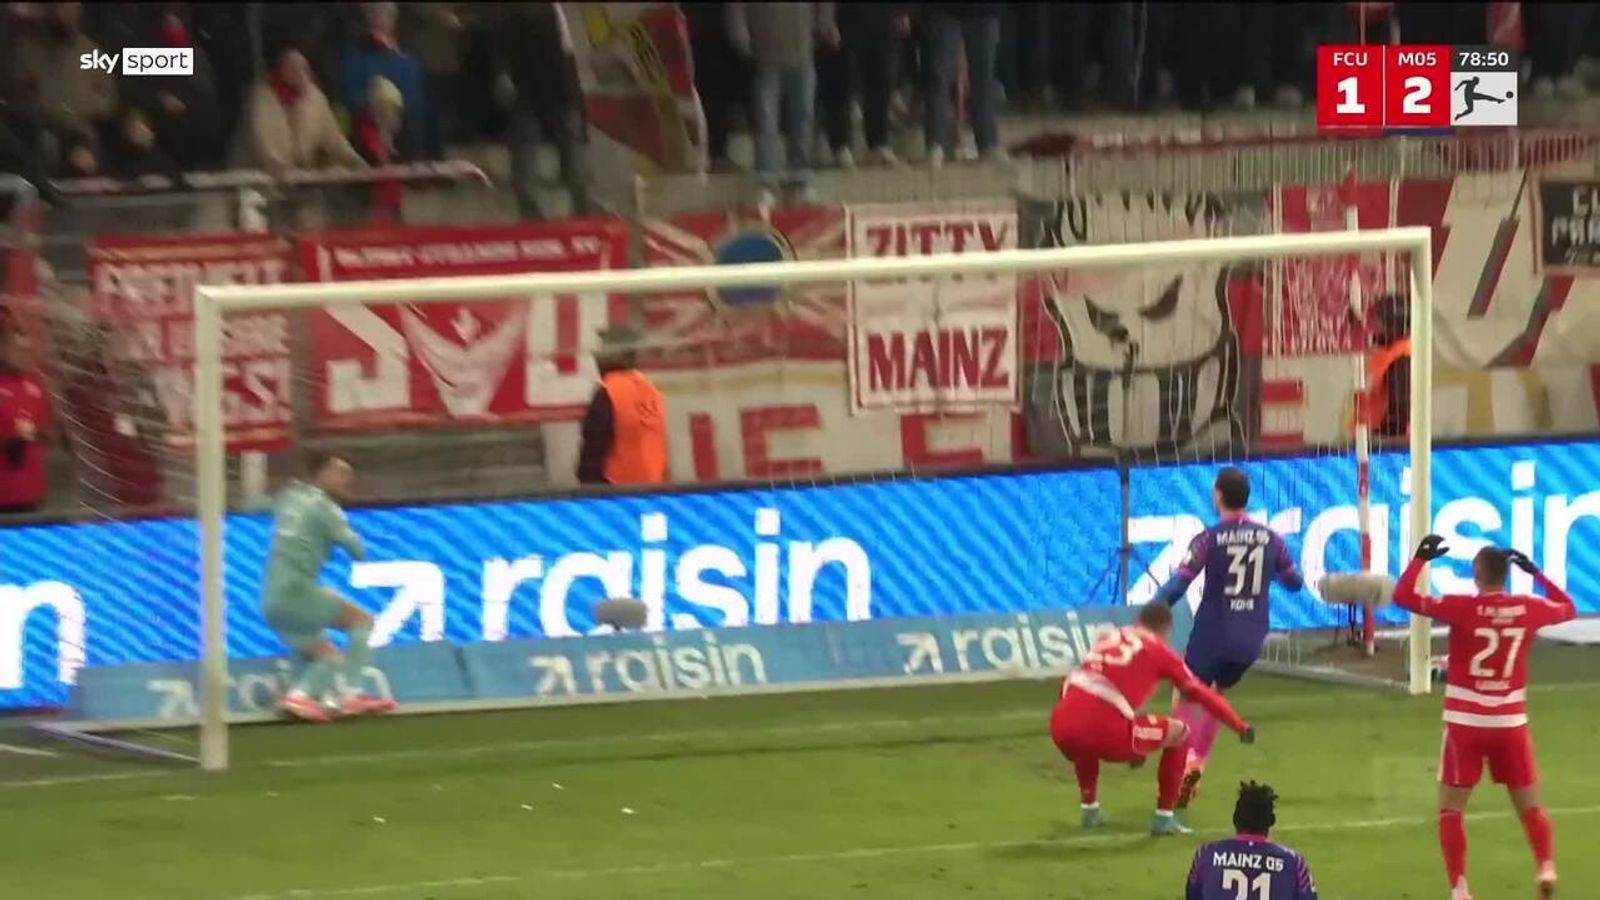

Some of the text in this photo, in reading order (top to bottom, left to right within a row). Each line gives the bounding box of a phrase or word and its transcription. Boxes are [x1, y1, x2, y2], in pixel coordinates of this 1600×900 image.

[866, 328, 1010, 392] MAINZ
[482, 508, 872, 641] raisin
[1224, 545, 1265, 596] 31
[587, 631, 767, 694] raisin
[1469, 627, 1527, 679] 27
[1212, 851, 1285, 872] MAINZ 05
